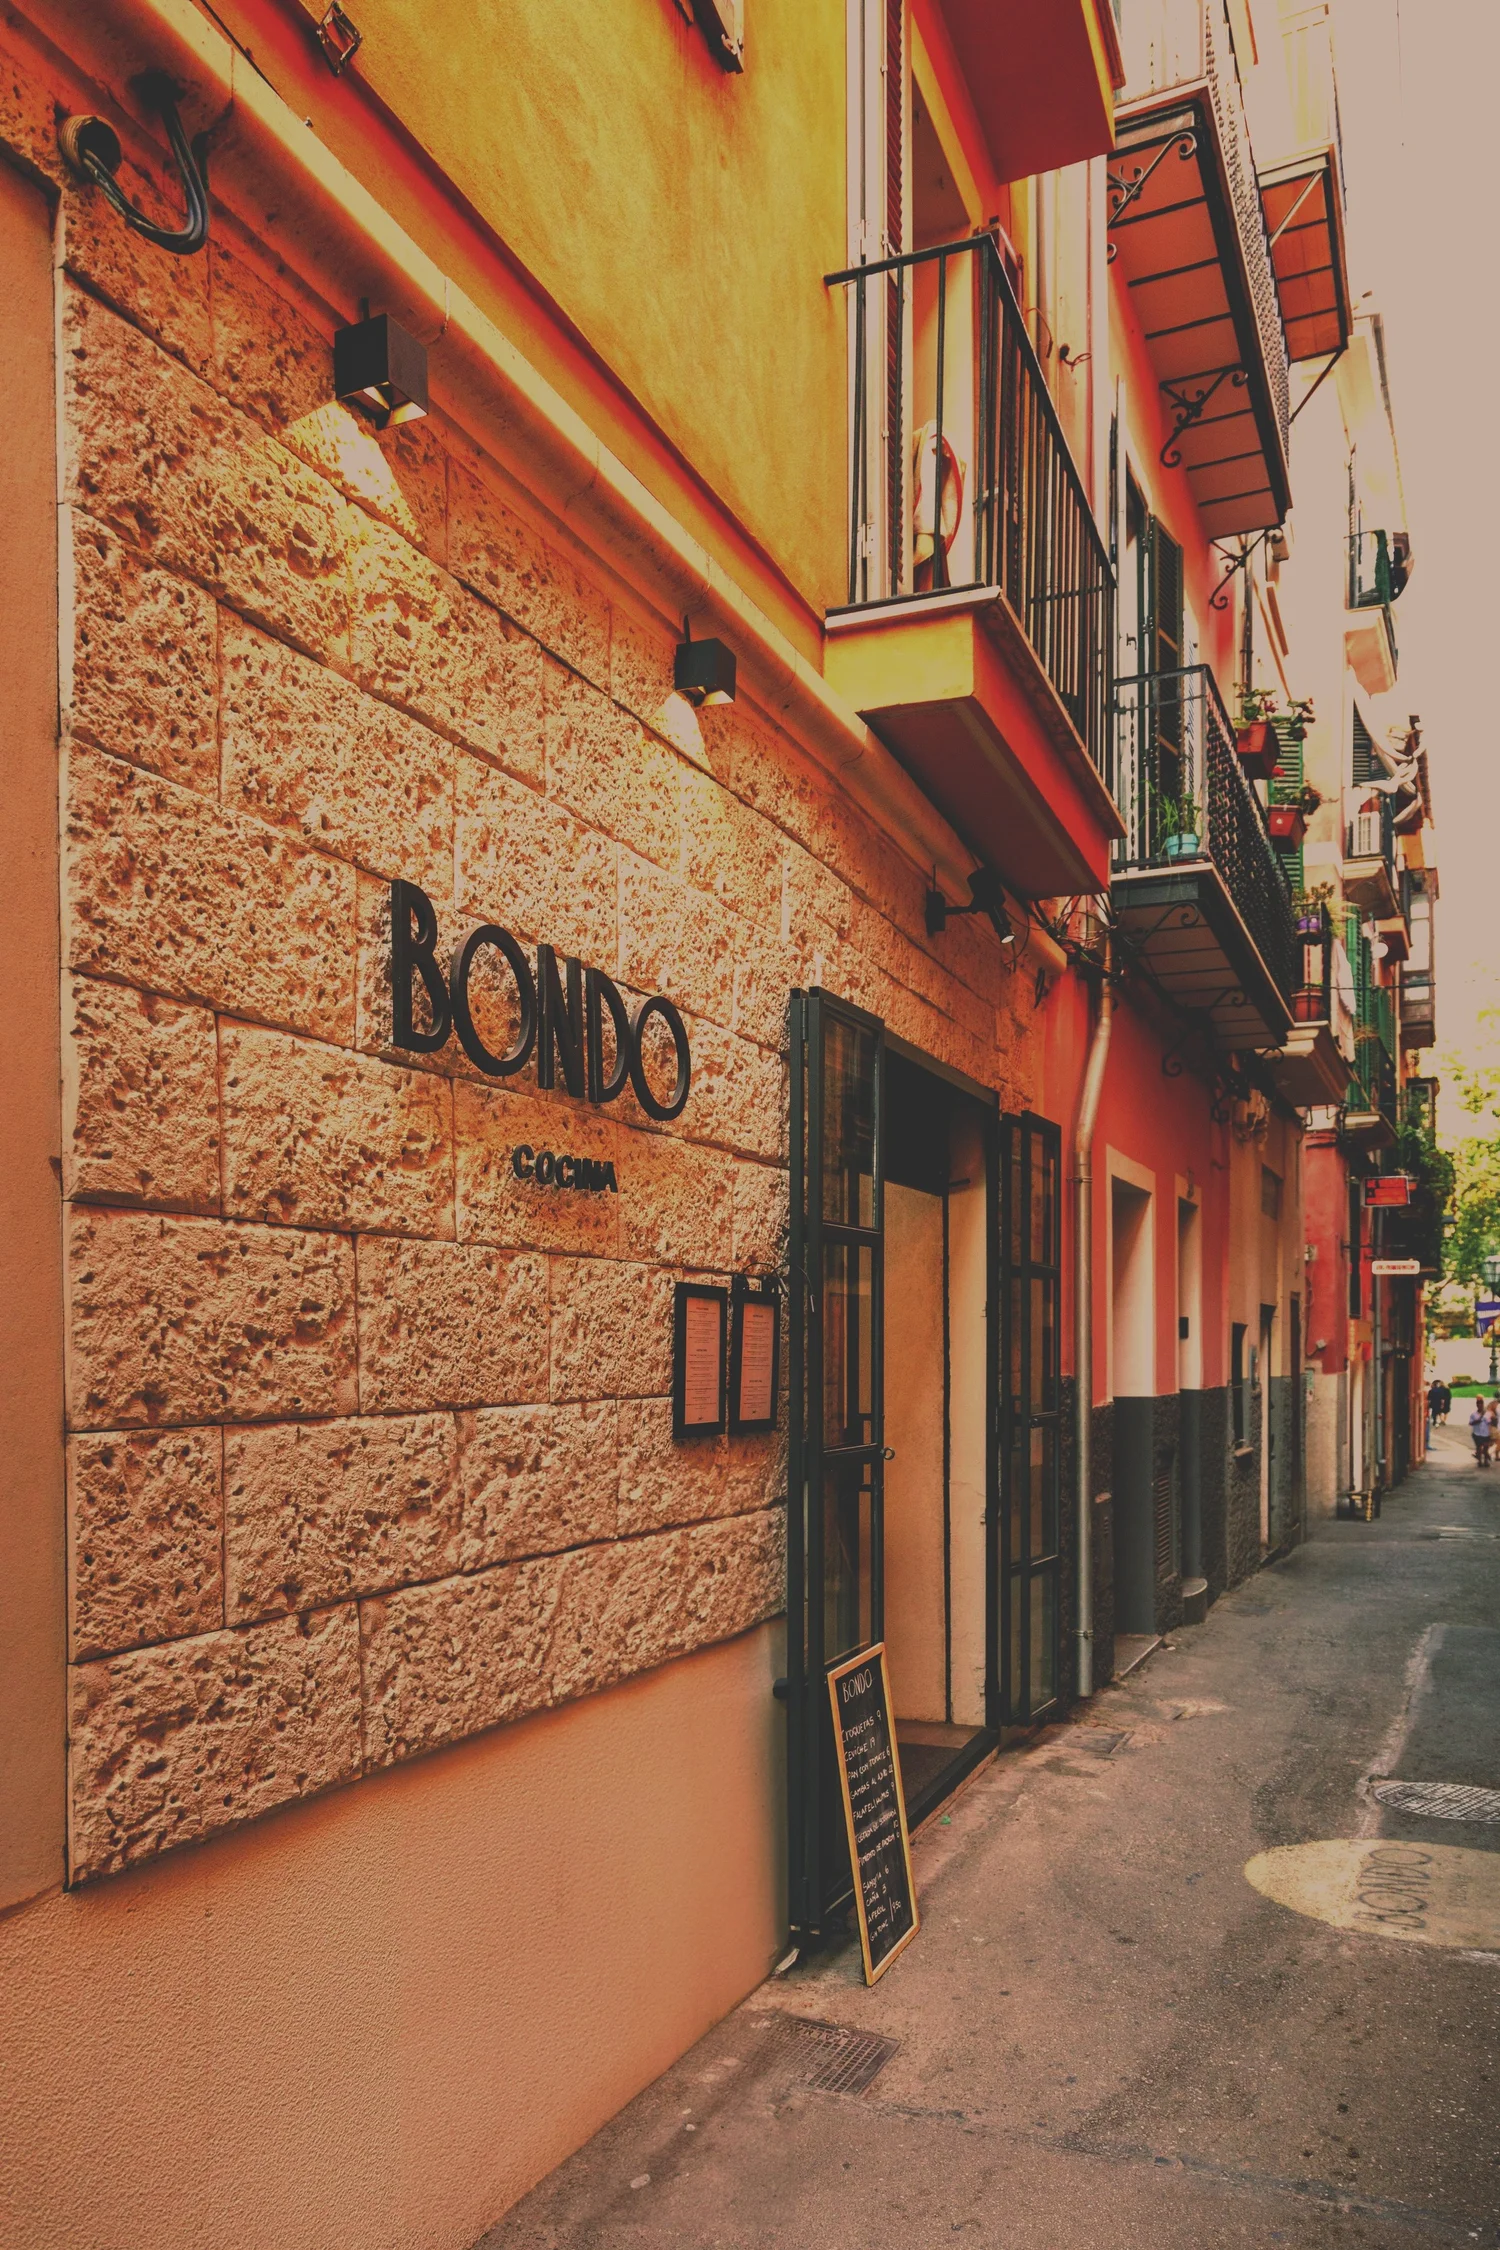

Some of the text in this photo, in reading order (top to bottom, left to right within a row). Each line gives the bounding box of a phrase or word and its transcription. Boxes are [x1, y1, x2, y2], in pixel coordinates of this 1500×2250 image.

[391, 879, 691, 1121] BONDO
[513, 1144, 618, 1193] COCINA
[842, 1668, 873, 1703] BONDO
[876, 1709, 882, 1721] 9
[848, 1769, 859, 1781] PAN
[859, 1763, 869, 1775] CON
[868, 1750, 886, 1767] TOMATE
[850, 1781, 870, 1800] GAMBAS
[1354, 1848, 1432, 1929] BONDO
[867, 1904, 886, 1924] APEROL
